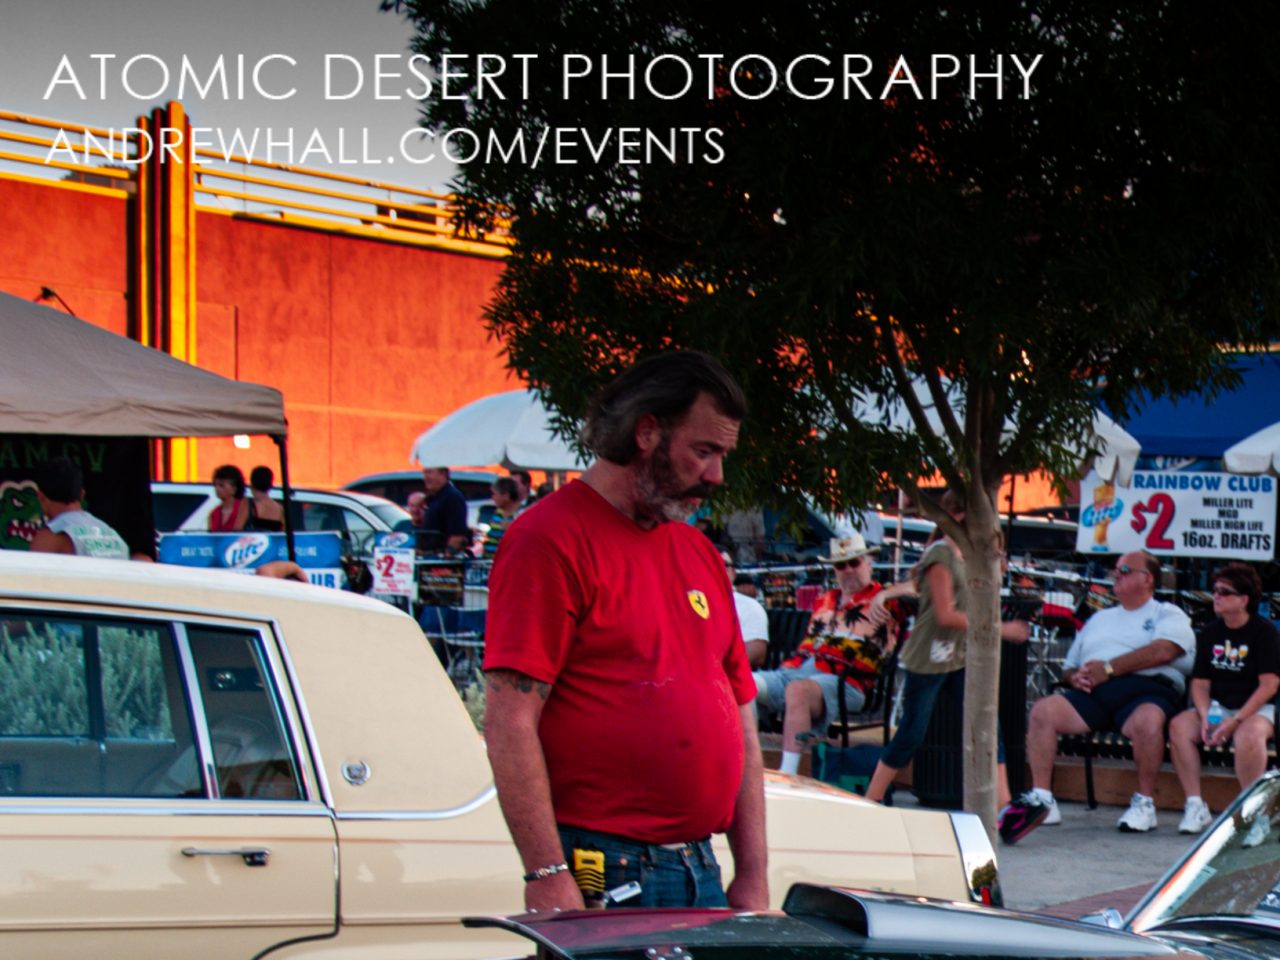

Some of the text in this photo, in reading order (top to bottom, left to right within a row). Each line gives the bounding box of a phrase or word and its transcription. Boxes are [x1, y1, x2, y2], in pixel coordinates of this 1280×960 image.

[1133, 473, 1273, 493] RAINBOW CLUB
[1202, 496, 1254, 509] MILLER LITE
[1130, 492, 1176, 550] $2
[1217, 508, 1239, 519] MGD
[1190, 518, 1264, 532] MILLER HIGH LIFE
[1182, 531, 1271, 551] 16oz. DRAFTS
[376, 554, 396, 577] $2
